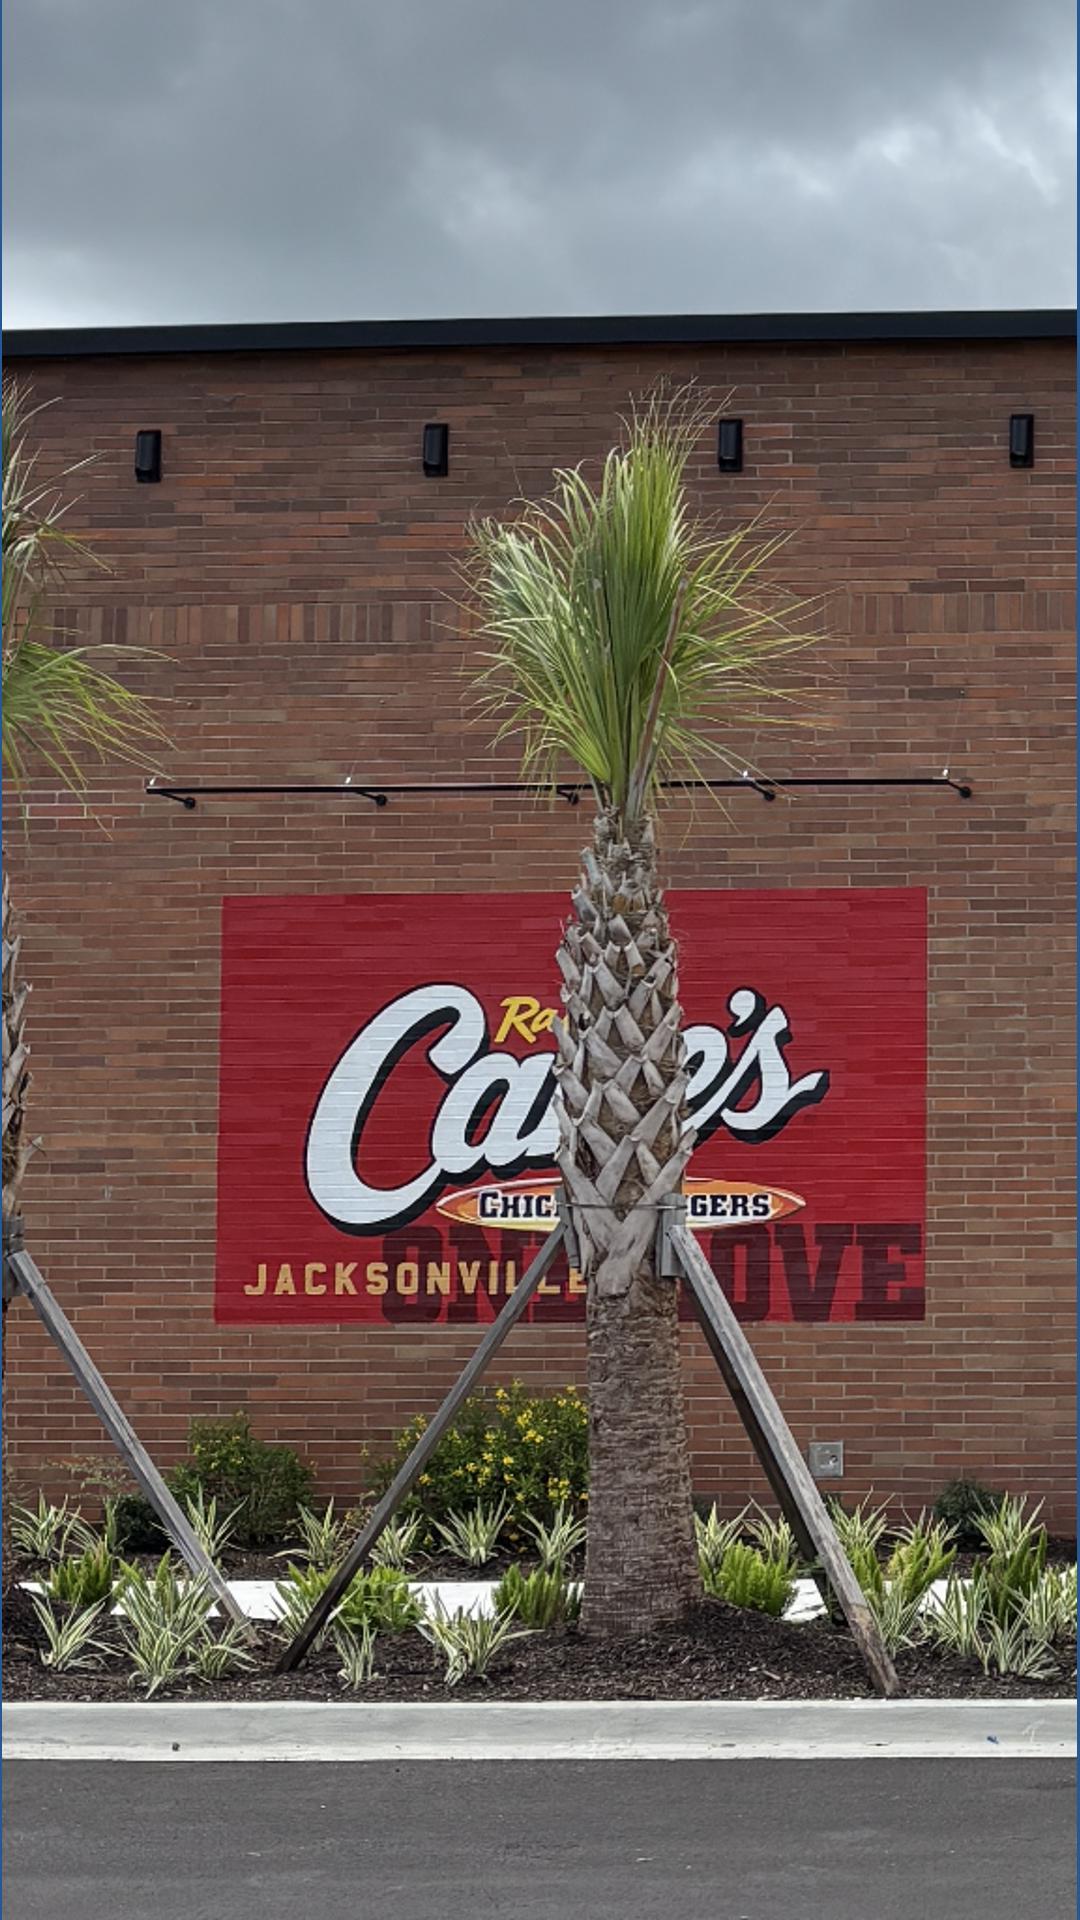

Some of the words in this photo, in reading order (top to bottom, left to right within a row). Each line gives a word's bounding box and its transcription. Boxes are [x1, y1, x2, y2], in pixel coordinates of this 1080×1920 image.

[304, 981, 830, 1236] Cae's
[480, 1191, 560, 1218] CHIC
[689, 1194, 770, 1217] GERS
[677, 1222, 926, 1322] OVE
